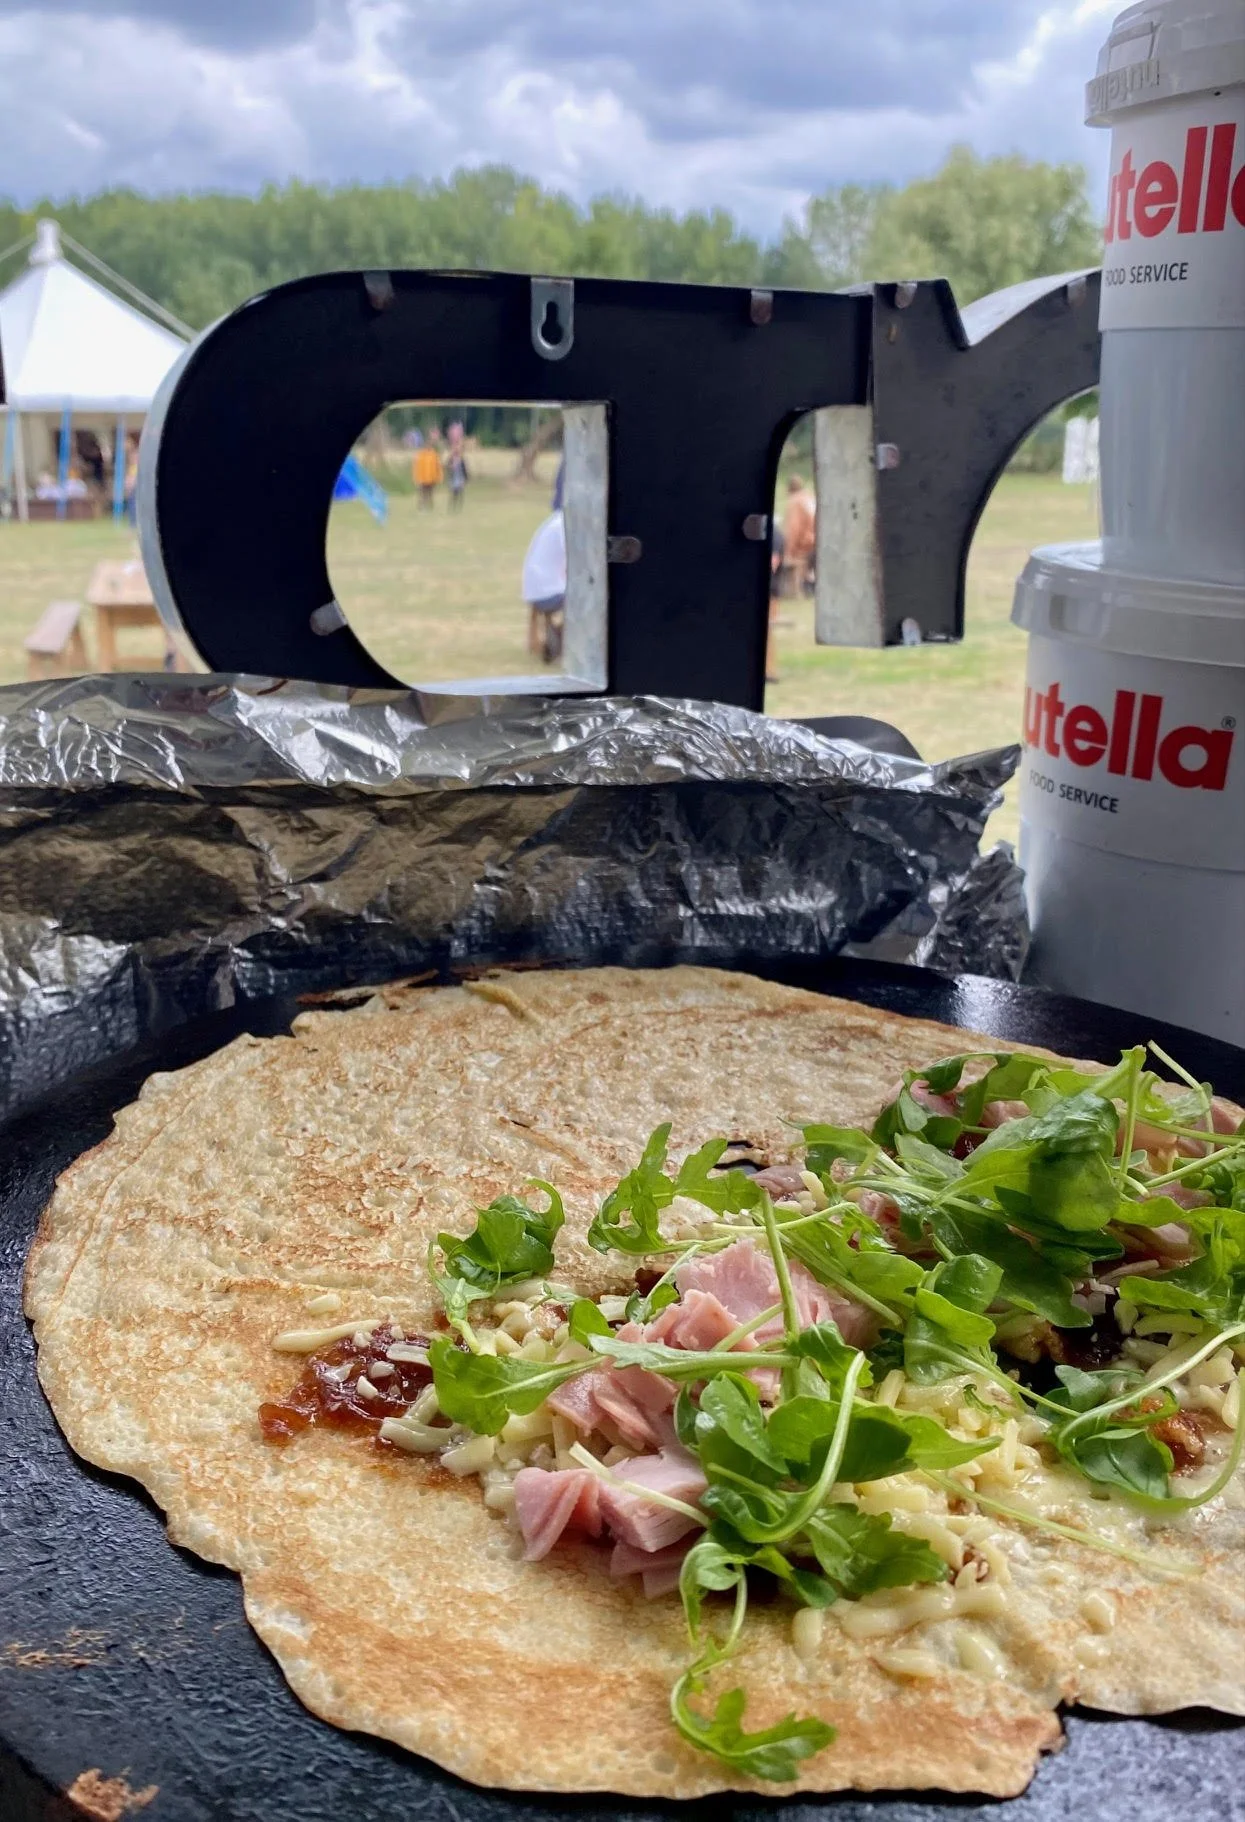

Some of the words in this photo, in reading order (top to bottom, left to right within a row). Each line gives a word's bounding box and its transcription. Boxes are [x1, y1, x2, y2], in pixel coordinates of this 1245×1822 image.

[1129, 262, 1189, 284] SERVICE
[1030, 769, 1054, 793] FOOD
[1058, 783, 1119, 813] SERVICE
